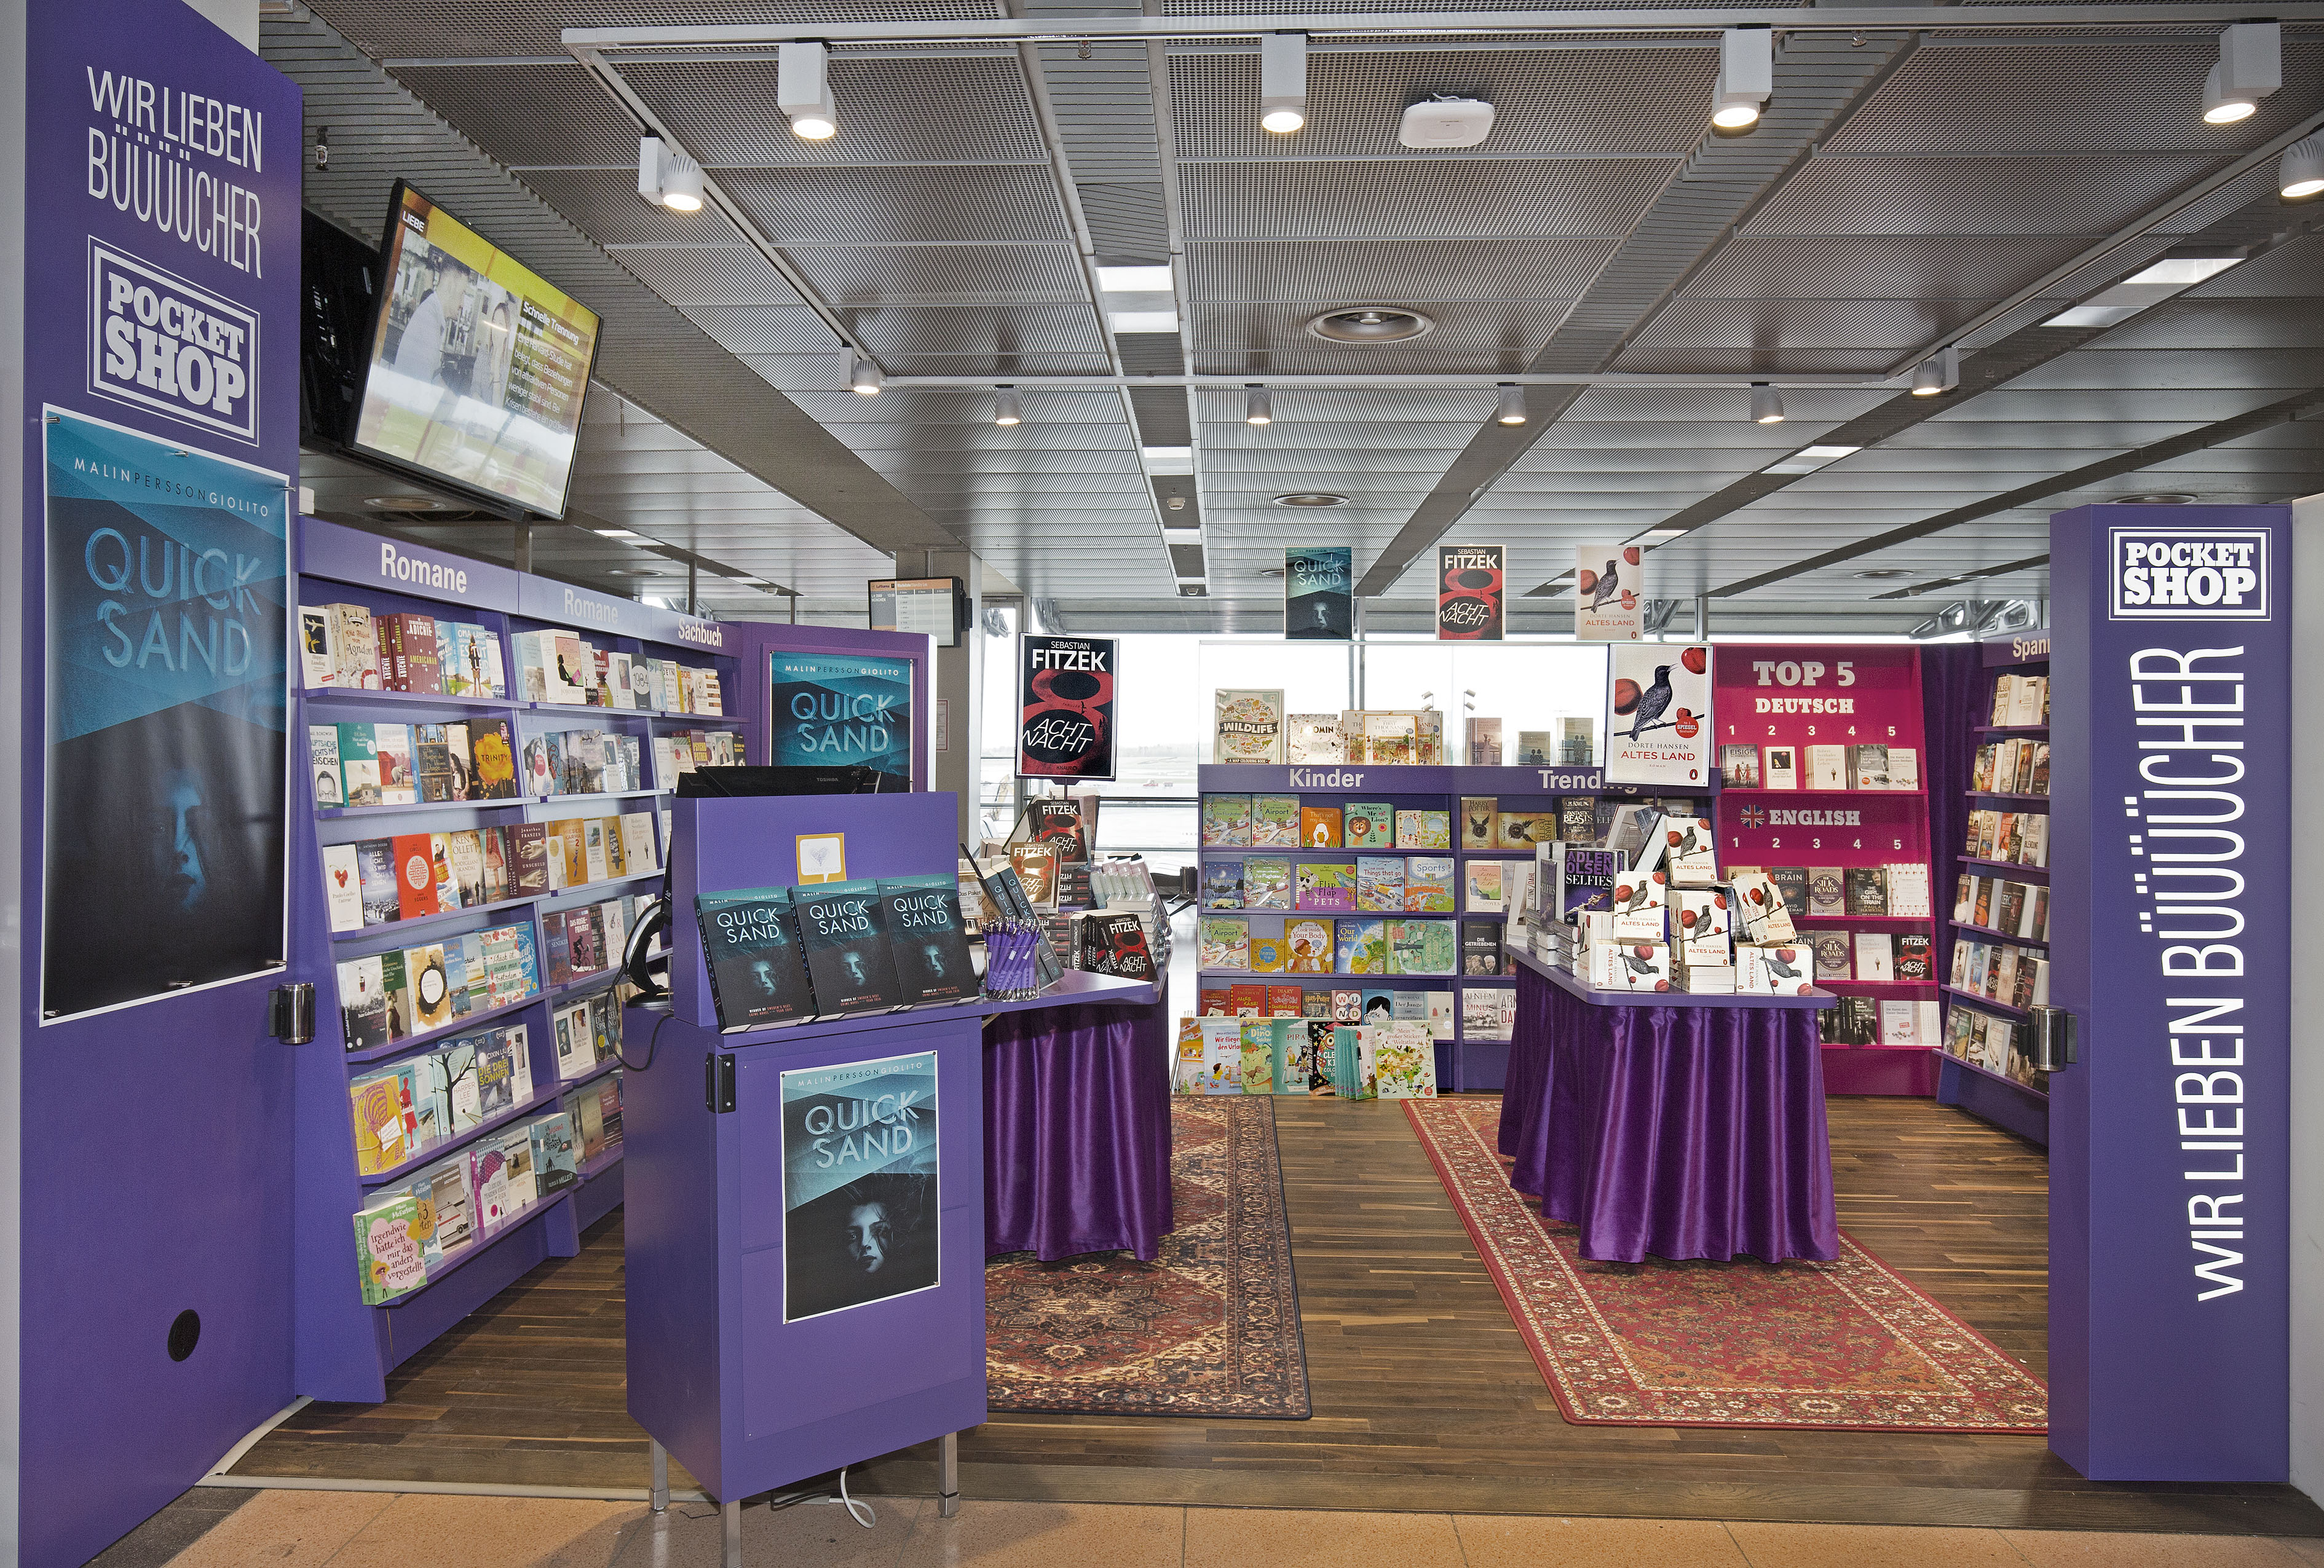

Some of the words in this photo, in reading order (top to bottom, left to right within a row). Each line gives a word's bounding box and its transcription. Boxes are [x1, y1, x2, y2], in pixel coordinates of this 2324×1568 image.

[87, 66, 156, 133] WIR
[164, 87, 262, 173] LIEBEN
[89, 125, 262, 279] BÜÜÜÜCHER
[403, 210, 425, 232] LIEBE
[108, 271, 244, 358] POCKET
[523, 301, 550, 326] Schnelle
[551, 318, 579, 345] Trennung
[106, 315, 246, 416] SHOP
[1445, 554, 1498, 569] FITZEK
[2125, 542, 2254, 567] POCKET
[85, 527, 263, 615] QUICK
[381, 543, 467, 593] Romane
[1294, 560, 1345, 572] QUICK
[1297, 573, 1341, 586] SAND
[2124, 567, 2256, 605] SHOP
[564, 588, 619, 624] Romane
[1447, 602, 1488, 615] ACHT
[1439, 611, 1489, 626] NACHT
[97, 599, 251, 677] SAND
[409, 624, 433, 637] ADICHIE
[678, 617, 722, 647] Sachbuch
[1051, 640, 1090, 650] SEBASTIAN
[1032, 648, 1107, 671] FITZEK
[1753, 661, 1825, 687] TOP
[1837, 661, 1856, 687] 5
[791, 692, 895, 723] QUICK
[1755, 698, 1854, 714] DEUTSCH
[797, 723, 889, 753] SAND
[1034, 719, 1093, 738] ACHT
[1223, 723, 1274, 735] WILDLIFE
[1728, 725, 1735, 735] 1
[1768, 725, 1776, 735] 2
[1808, 726, 1816, 736] 3
[1848, 727, 1856, 736] 4
[1888, 727, 1896, 736] 5
[1022, 730, 1093, 753] NACHT
[481, 754, 508, 762] TRINITY
[1621, 751, 1658, 759] ALTES
[1662, 752, 1695, 761] LAND
[1289, 768, 1364, 787] Kinder
[1538, 770, 1638, 794] Trend
[1042, 805, 1078, 815] FITZEK
[1563, 814, 1594, 824] BEASTS
[1769, 810, 1861, 826] ENGLISH
[2124, 645, 2244, 977] BÜÜÜÜCHER
[456, 836, 470, 845] KEN
[1049, 836, 1076, 846] ACHT
[1733, 837, 1739, 848] 1
[1772, 838, 1781, 848] 2
[1812, 838, 1820, 849] 3
[1853, 839, 1862, 849] 4
[1894, 840, 1902, 850] 5
[1014, 847, 1053, 857] FITZEK
[1566, 851, 1613, 862] ADLER
[1417, 864, 1445, 873] Sports
[1566, 862, 1613, 875] OLSEN
[1319, 880, 1336, 889] Flip
[1565, 874, 1613, 887] SELFIES
[809, 899, 869, 920] QUICK
[894, 894, 948, 912] QUICK
[717, 907, 780, 928] QUICK
[819, 916, 869, 936] SAND
[903, 910, 947, 928] SAND
[727, 924, 780, 944] SAND
[1109, 921, 1140, 934] FITZEK
[1108, 948, 1118, 970] FITZEK
[1119, 963, 1147, 972] NACHT
[1123, 956, 1145, 965] ACHT
[478, 1064, 492, 1076] DIE
[492, 1057, 509, 1073] DREI
[479, 1068, 509, 1086] SONNEN
[453, 1082, 476, 1094] HARPER
[459, 1090, 471, 1100] LEE
[2166, 998, 2244, 1180] LIEBEN
[805, 1089, 920, 1136] QUICK
[812, 1125, 913, 1169] SAND
[371, 1223, 406, 1245] Irgendwie
[376, 1240, 394, 1255] hatte
[394, 1234, 406, 1245] ich
[387, 1250, 401, 1261] mir
[401, 1243, 413, 1253] das
[2186, 1192, 2244, 1302] WIR
[387, 1261, 424, 1281] vorgestellt
[391, 1254, 414, 1269] anders
